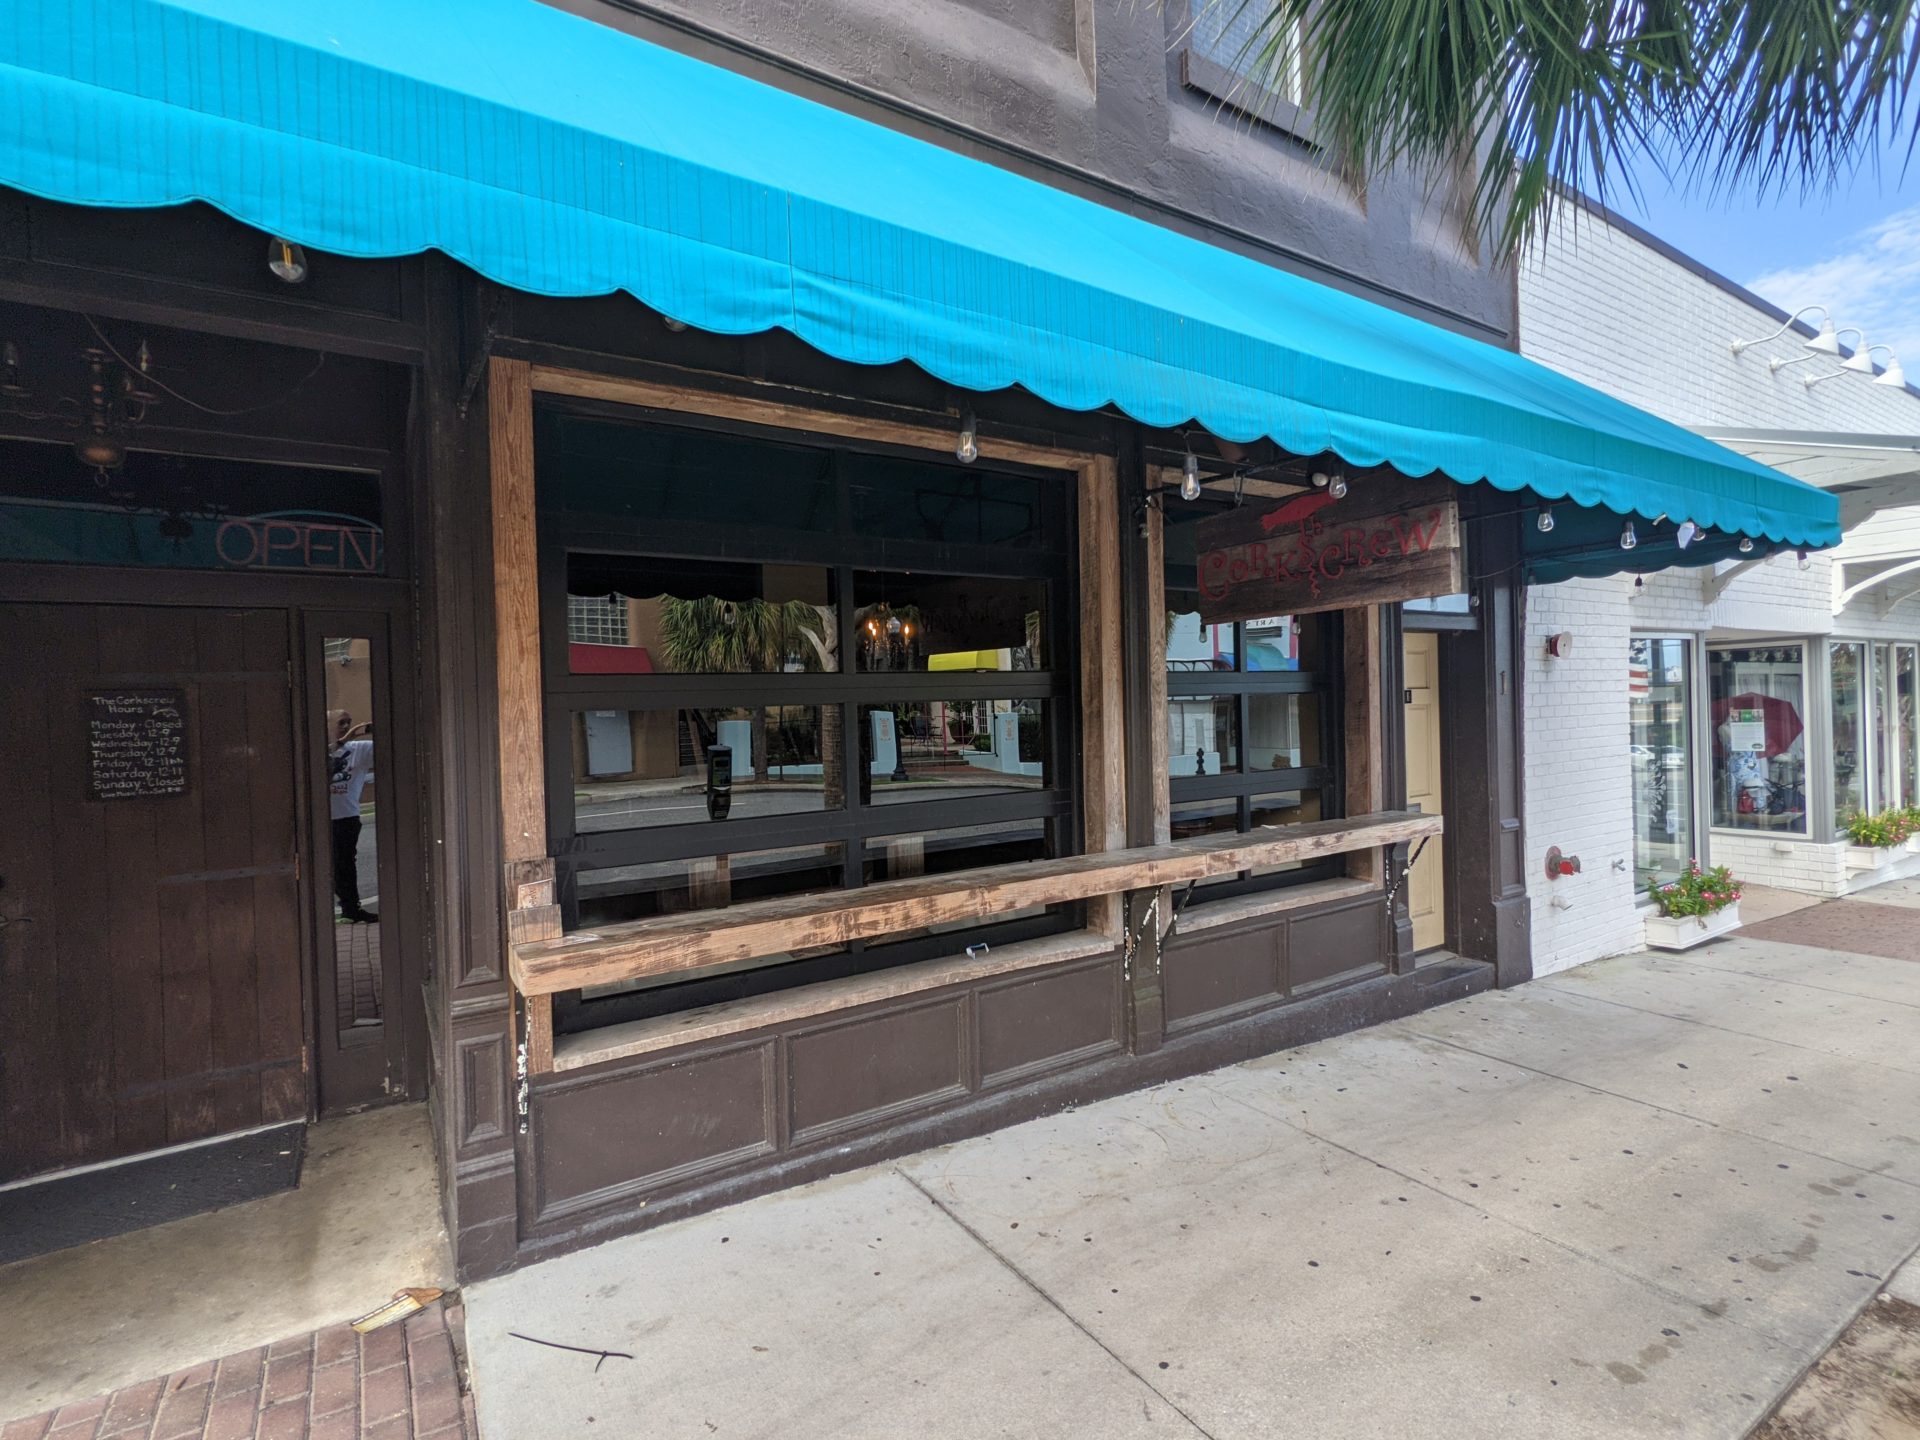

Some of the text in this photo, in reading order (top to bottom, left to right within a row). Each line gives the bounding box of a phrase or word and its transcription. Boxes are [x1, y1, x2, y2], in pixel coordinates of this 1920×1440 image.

[215, 520, 379, 571] OPEN
[92, 696, 174, 705] The Corkscrew
[108, 705, 143, 713] Hours
[91, 720, 136, 731] Monday
[144, 719, 183, 729] Closed
[91, 729, 140, 741] Tuesday
[91, 739, 153, 751] Wednesday
[91, 748, 148, 760] Thursday
[93, 759, 132, 770] Friday
[93, 767, 152, 780] Saturday
[94, 779, 142, 791] Sunday
[147, 776, 185, 787] Closed
